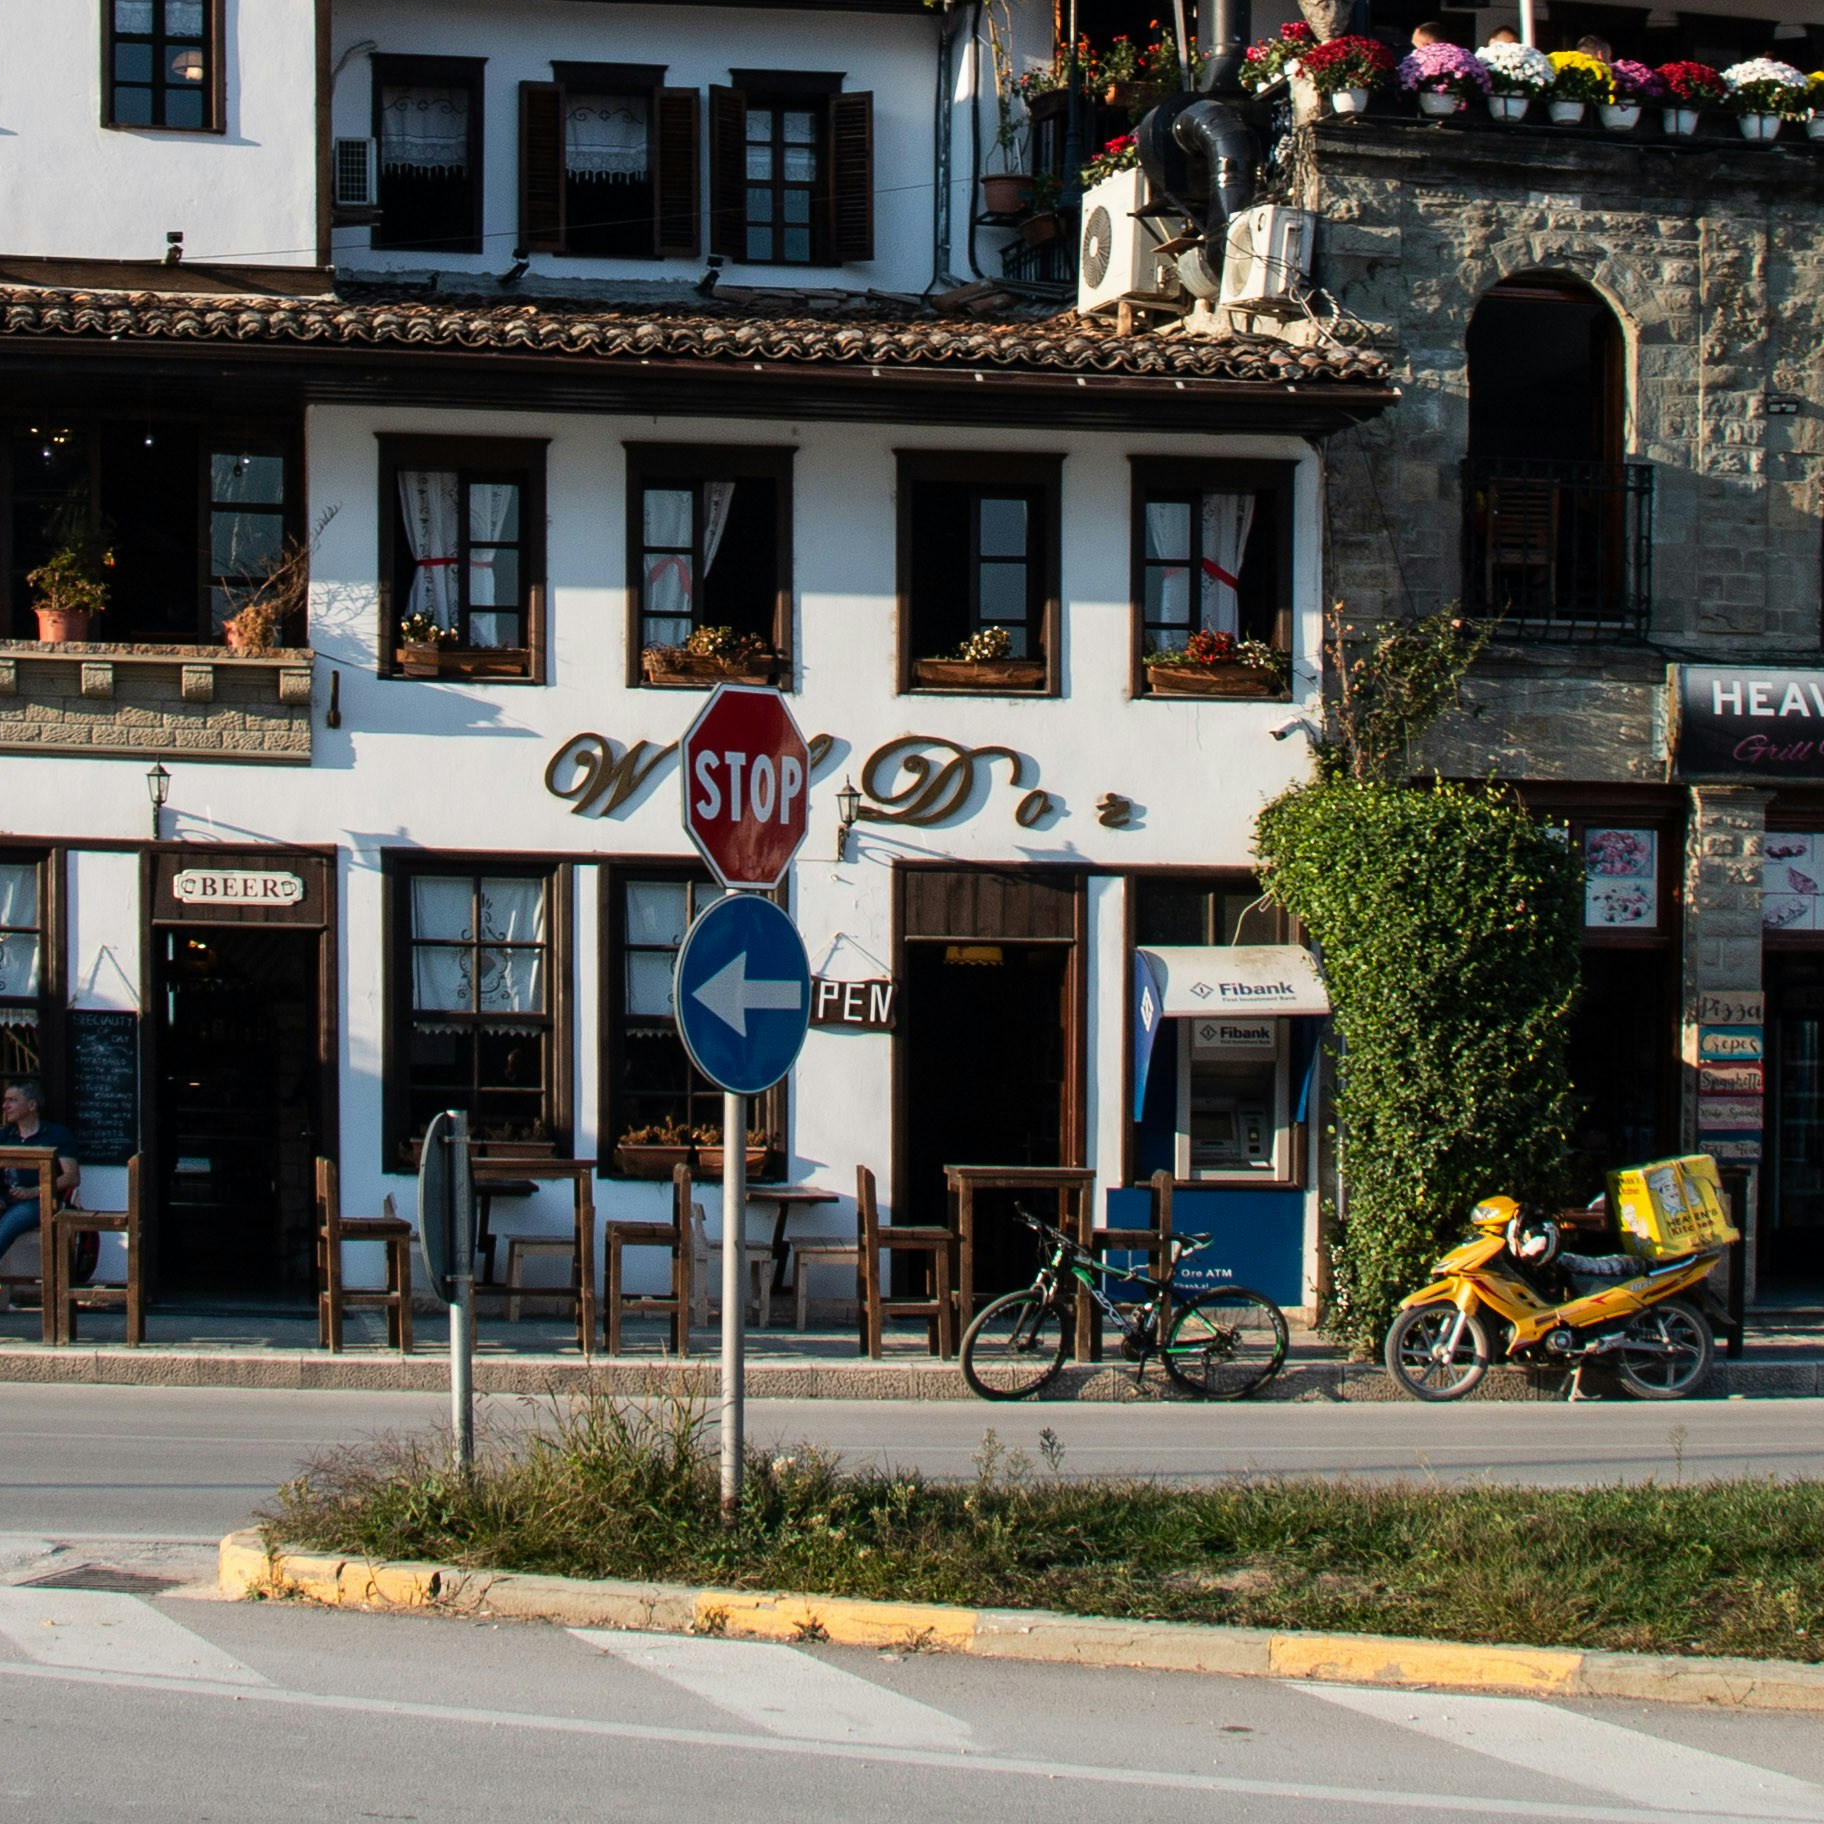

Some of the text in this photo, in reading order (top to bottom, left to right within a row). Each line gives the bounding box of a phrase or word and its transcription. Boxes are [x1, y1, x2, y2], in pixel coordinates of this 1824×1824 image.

[1733, 735, 1814, 763] Grill
[695, 749, 803, 825] STOP
[200, 877, 280, 897] BEER
[1219, 982, 1295, 996] Fibank
[816, 980, 893, 1023] PEN
[1701, 997, 1762, 1021] Pizza
[1220, 1026, 1270, 1039] Fibank
[1181, 1268, 1233, 1277] Ore ATM
